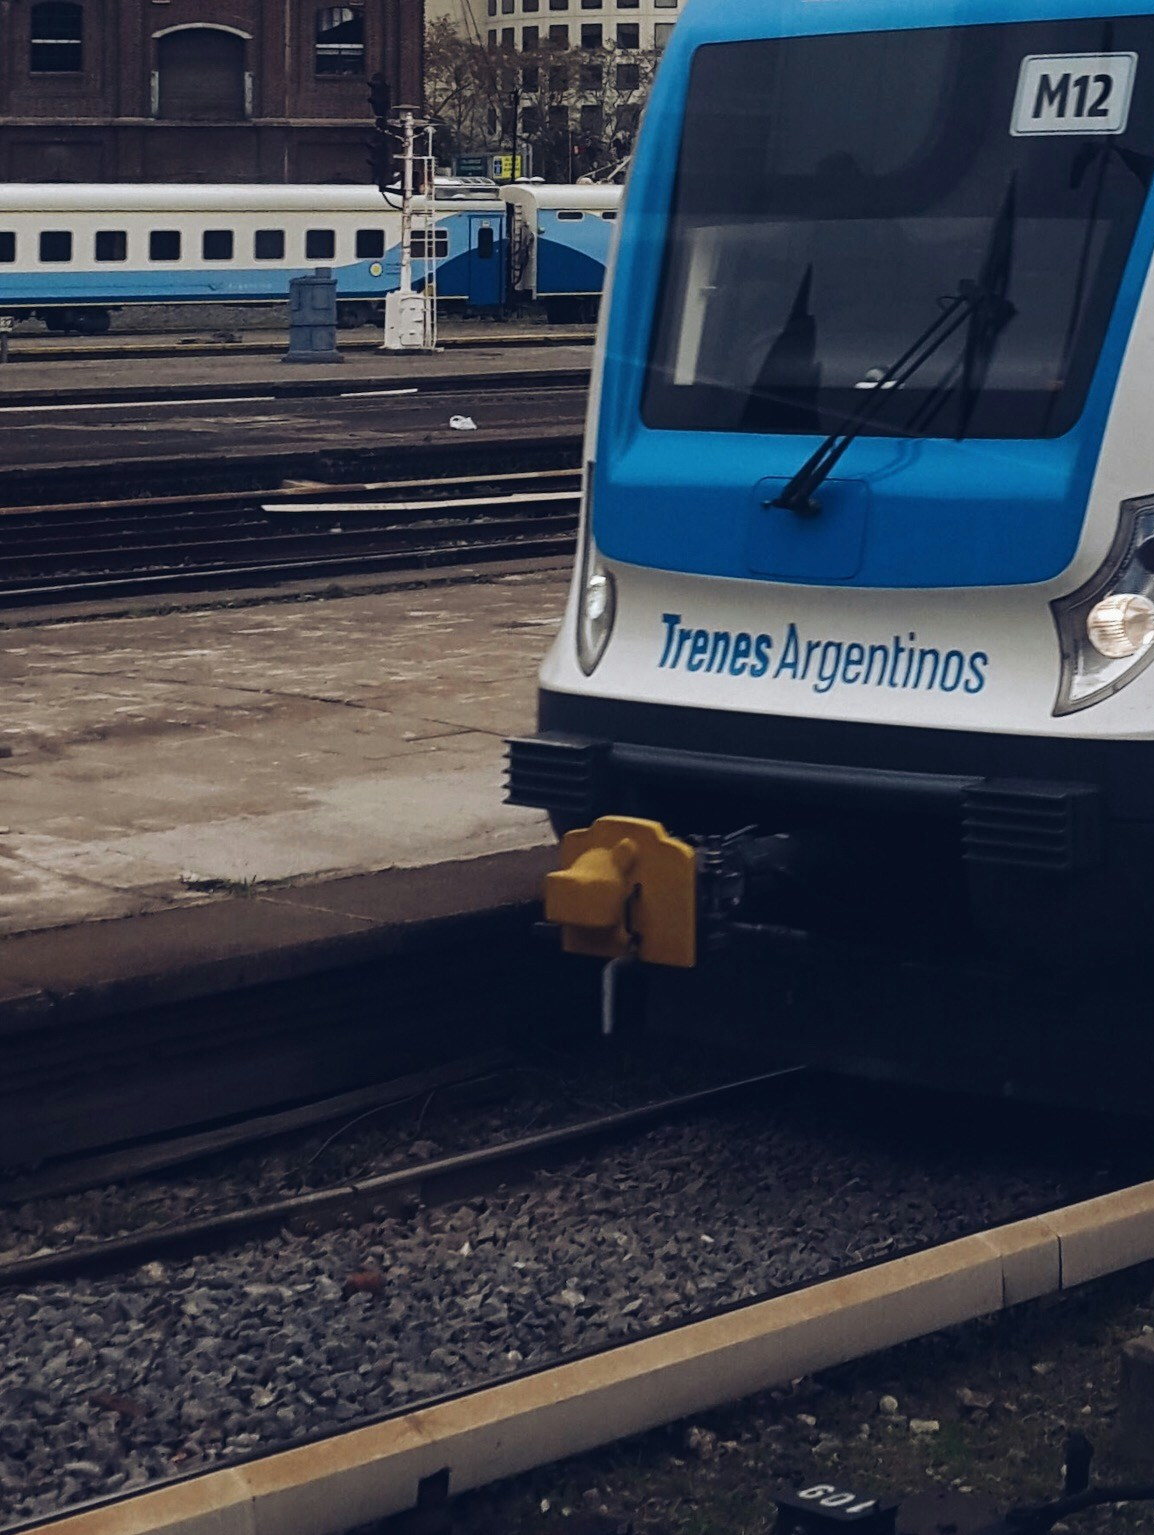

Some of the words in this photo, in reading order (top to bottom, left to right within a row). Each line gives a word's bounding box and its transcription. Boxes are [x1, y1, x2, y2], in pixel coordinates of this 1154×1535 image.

[1032, 73, 1113, 119] M12
[658, 613, 773, 678] Trenes
[774, 623, 988, 694] Argentinos
